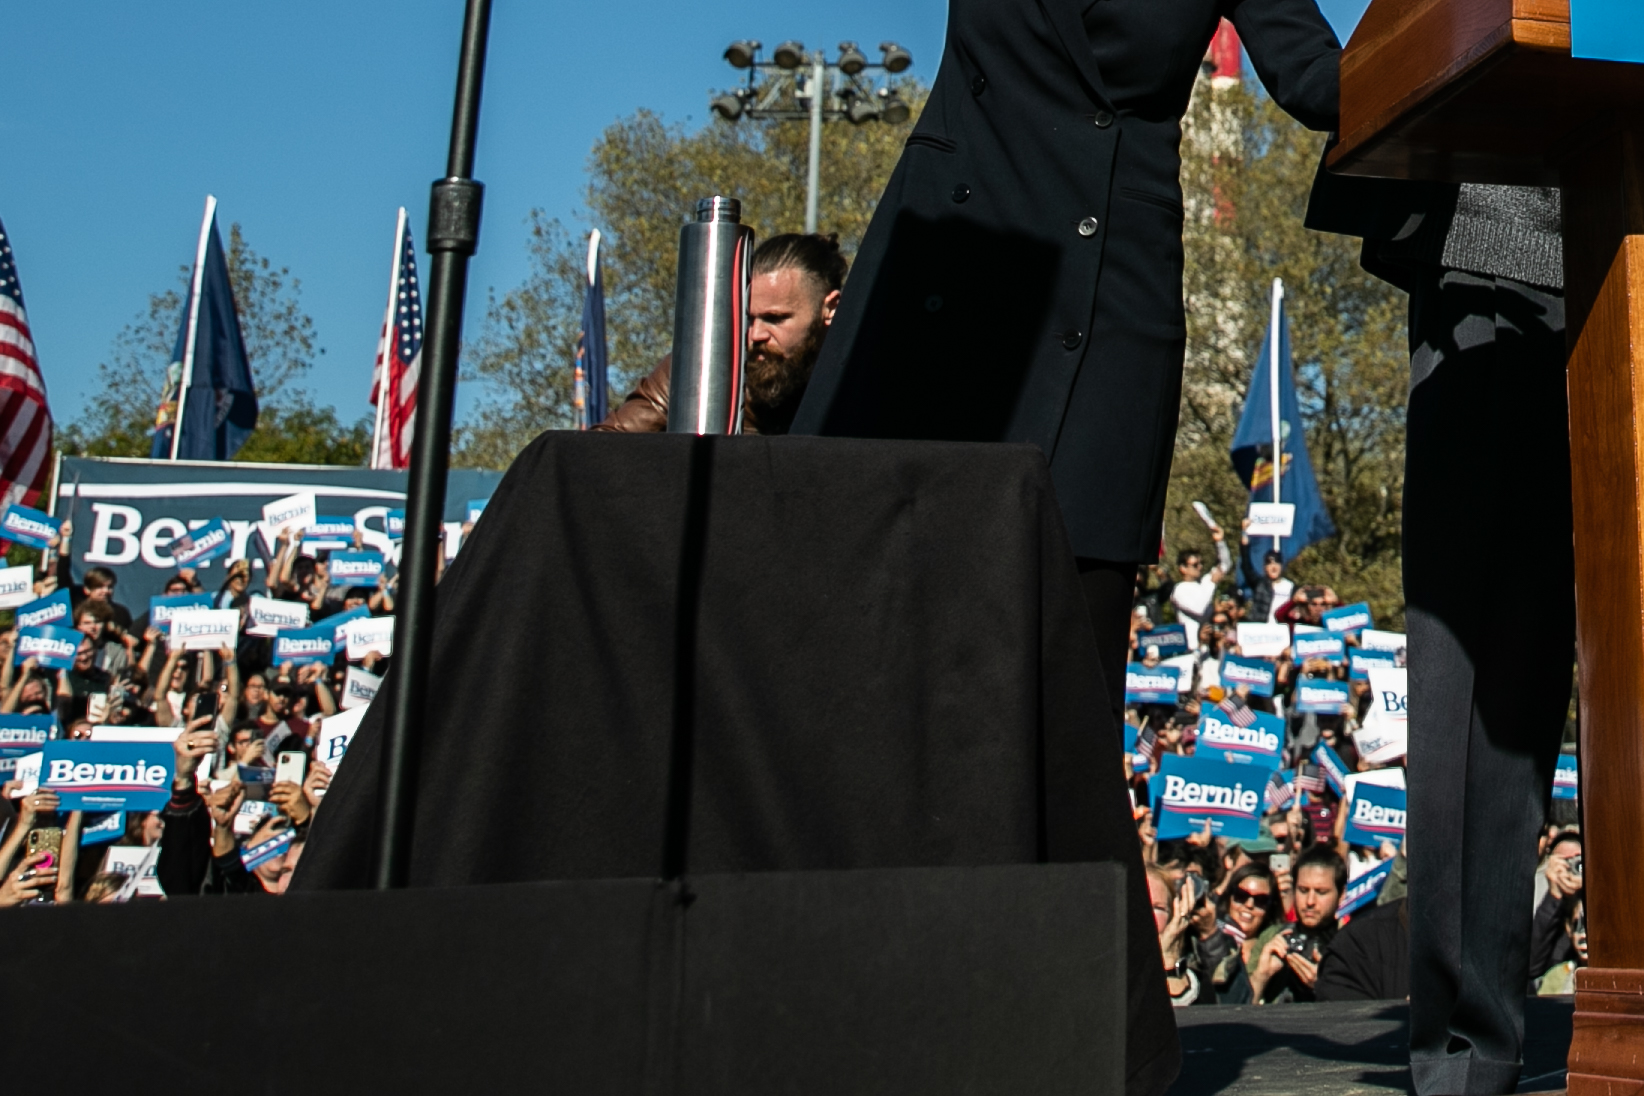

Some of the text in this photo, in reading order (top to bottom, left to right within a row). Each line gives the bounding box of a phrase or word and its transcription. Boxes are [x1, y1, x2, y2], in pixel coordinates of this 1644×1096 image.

[6, 512, 57, 538] Bernie
[331, 559, 382, 574] Bernie
[18, 602, 67, 626] Bernie
[254, 608, 301, 626] Bernie
[1326, 611, 1369, 632] Bernie
[177, 622, 232, 635] Bernie
[18, 636, 76, 656] Bernie
[278, 636, 332, 653] Bernie
[1296, 636, 1342, 654] Bernie
[1224, 661, 1273, 683] Bernie
[1301, 686, 1348, 703] Bernie
[0, 727, 47, 743] ernie
[1203, 717, 1279, 752] Bernie
[46, 759, 168, 787] Bernie
[1162, 775, 1259, 814] Bernie
[1354, 798, 1407, 828] Bern
